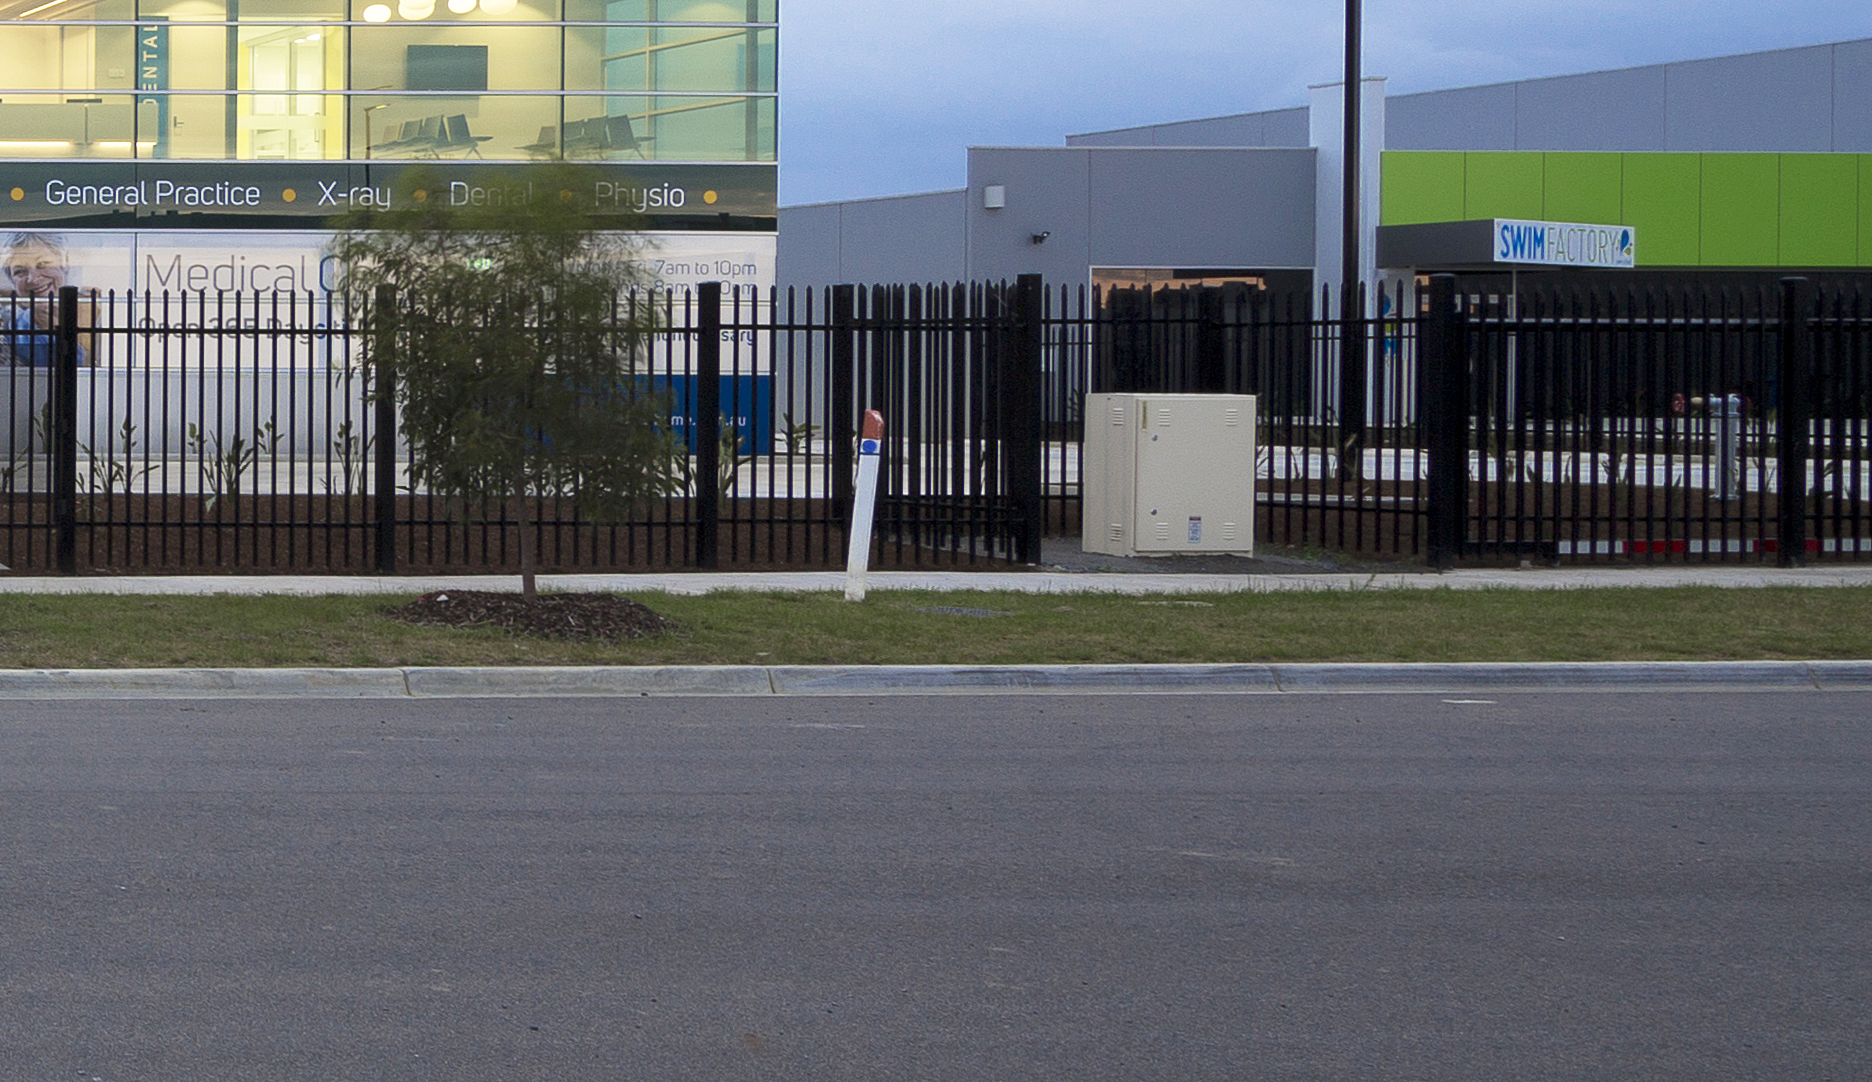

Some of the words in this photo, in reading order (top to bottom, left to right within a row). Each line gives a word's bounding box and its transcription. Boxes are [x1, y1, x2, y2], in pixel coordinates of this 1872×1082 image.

[45, 180, 148, 205] General
[156, 180, 260, 205] Practice
[317, 180, 391, 211] X-ray
[450, 181, 533, 206] Denal
[595, 182, 685, 213] Physio
[146, 254, 312, 293] Medical
[655, 260, 690, 275] 7am
[695, 261, 709, 275] to
[715, 260, 757, 278] 10pm
